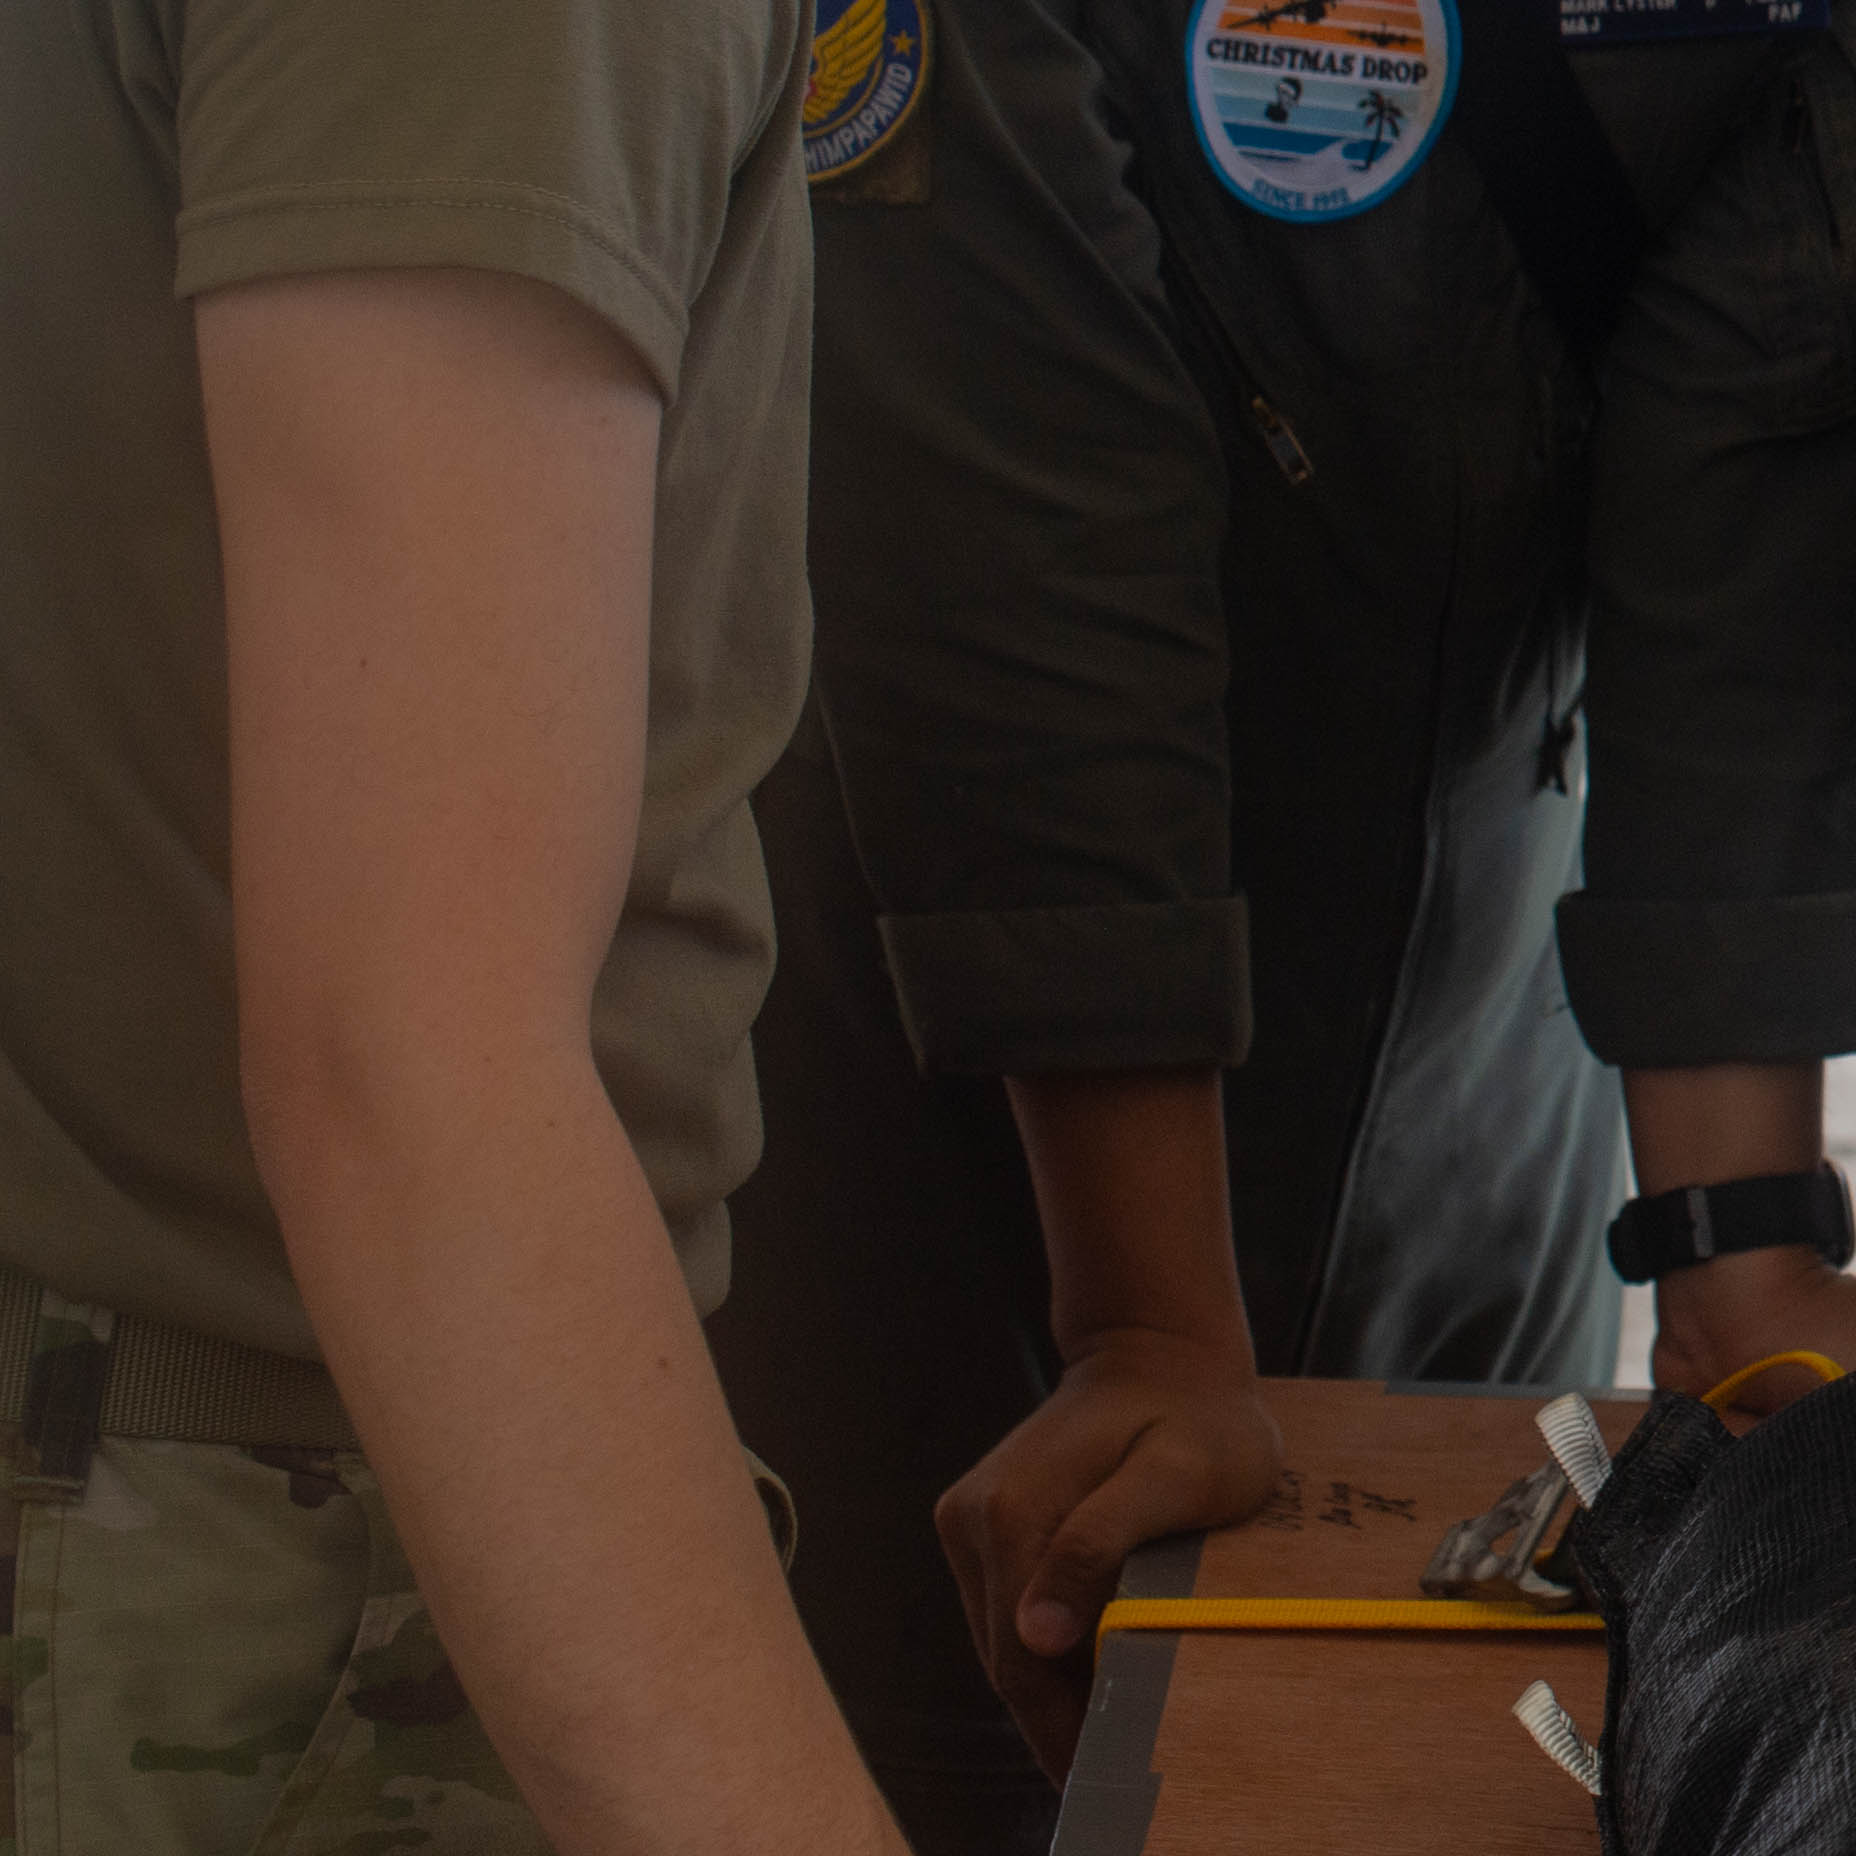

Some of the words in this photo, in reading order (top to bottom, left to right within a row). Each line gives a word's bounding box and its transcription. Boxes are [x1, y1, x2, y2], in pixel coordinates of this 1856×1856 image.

[1768, 2, 1803, 24] PAF
[1559, 15, 1602, 36] MAJ
[1207, 37, 1354, 76] CHRISTMAS
[1361, 56, 1428, 85] DROP
